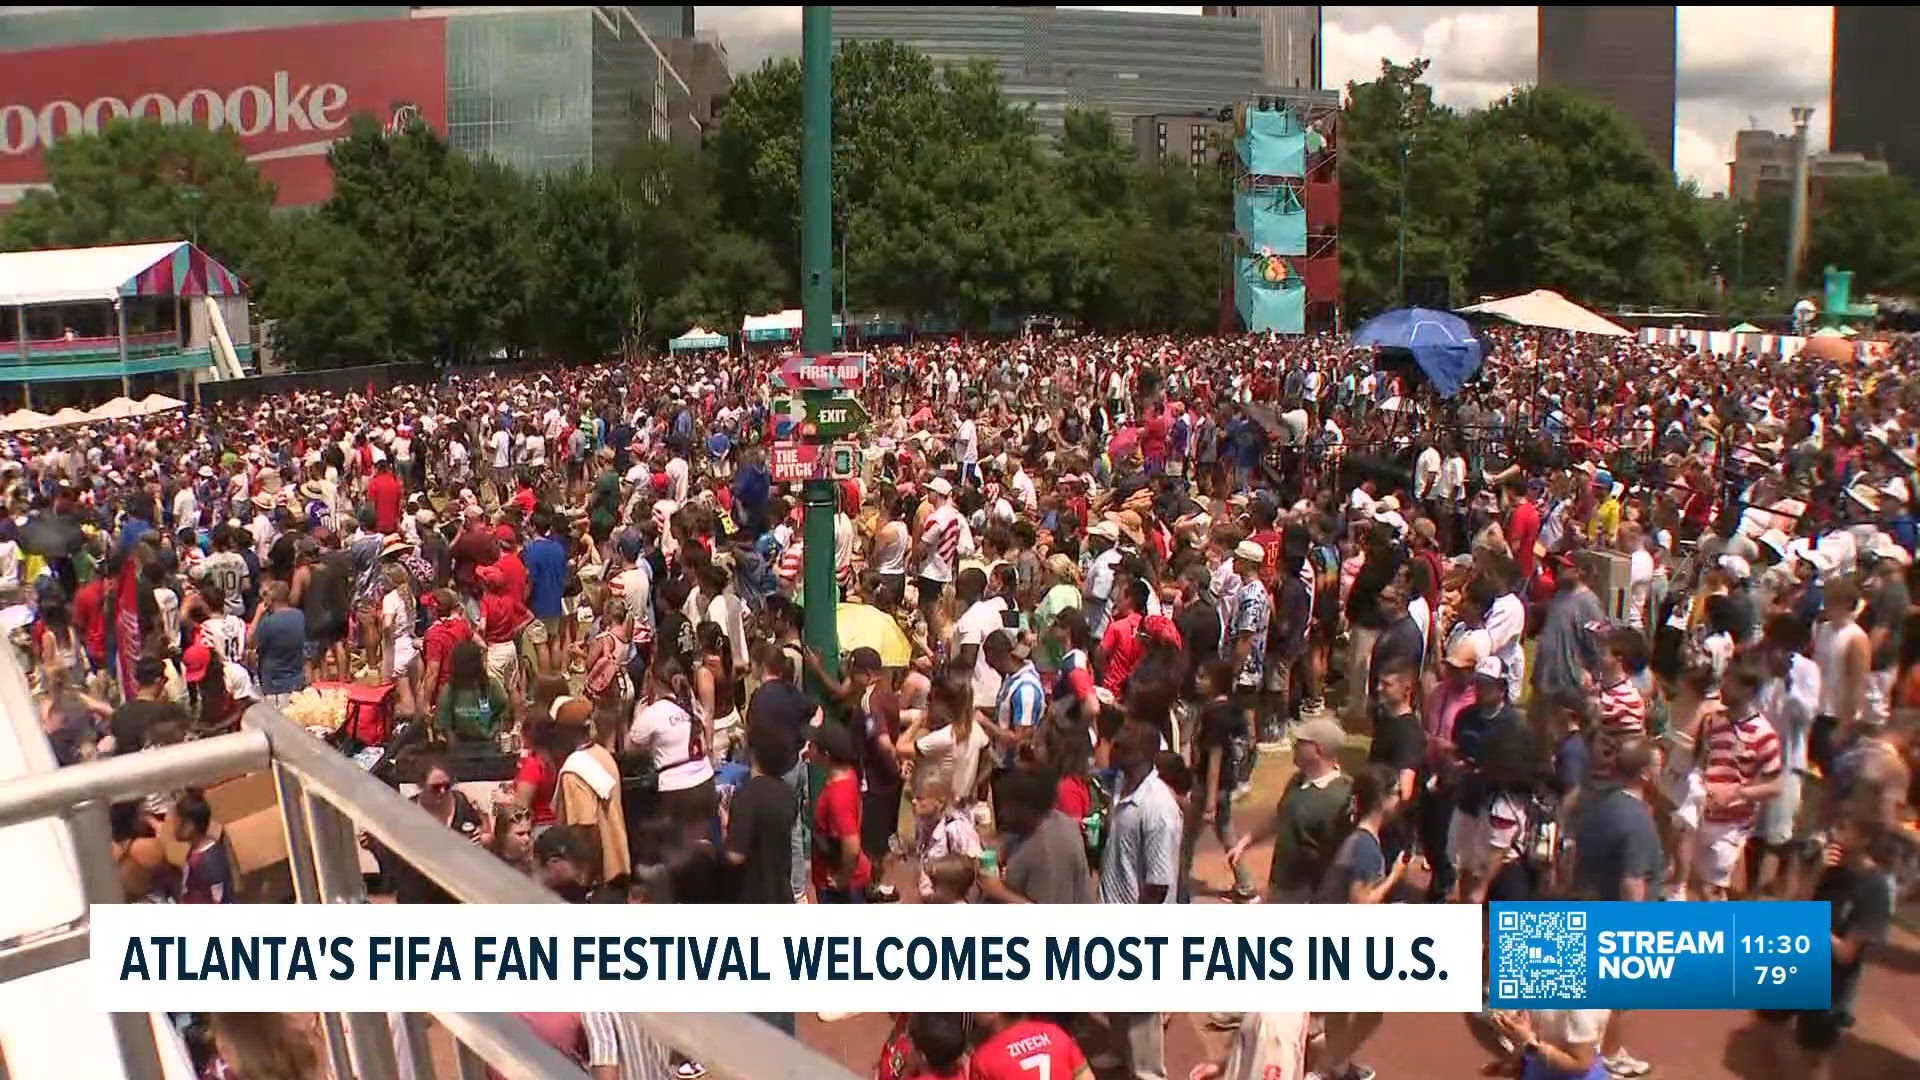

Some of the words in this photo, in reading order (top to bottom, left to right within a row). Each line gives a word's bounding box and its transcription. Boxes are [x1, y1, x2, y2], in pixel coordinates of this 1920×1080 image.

[800, 365, 834, 379] FIRST
[837, 365, 859, 379] AID
[819, 408, 848, 423] EXIT
[775, 450, 799, 463] THE
[775, 463, 813, 478] PITCH
[1006, 1032, 1051, 1057] ZIYECH
